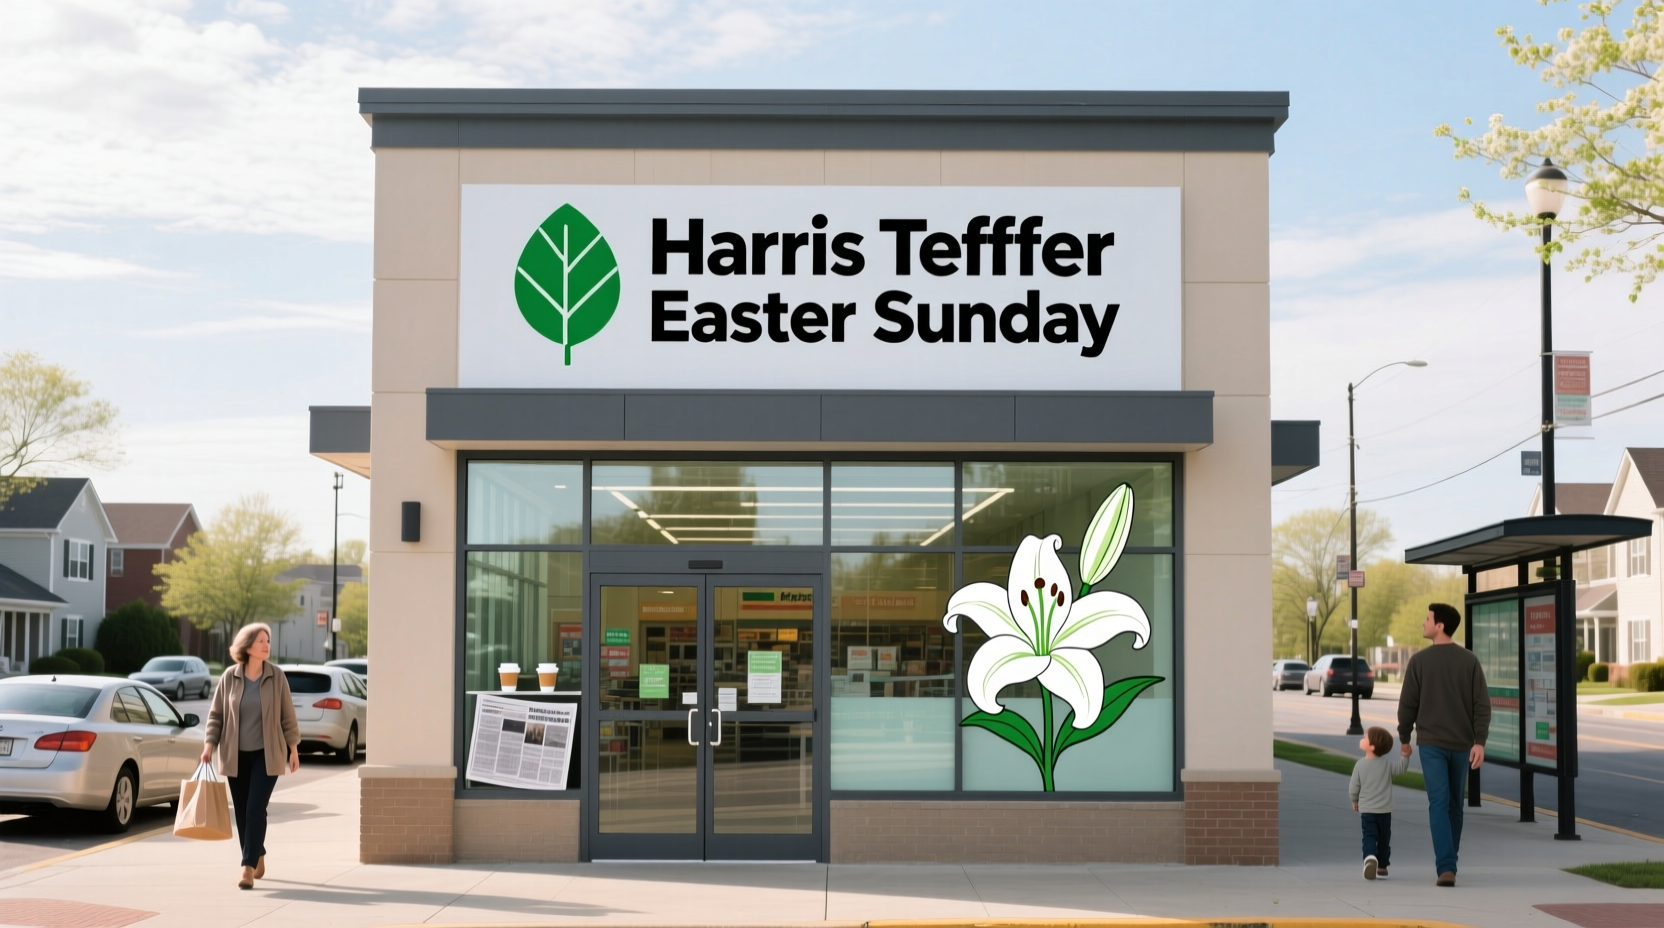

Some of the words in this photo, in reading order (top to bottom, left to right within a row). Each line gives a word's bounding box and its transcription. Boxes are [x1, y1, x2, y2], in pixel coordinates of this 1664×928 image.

[651, 213, 866, 277] Harris
[879, 215, 1115, 278] Tefffer
[651, 289, 857, 344] Easter
[873, 289, 1121, 358] Sunday
